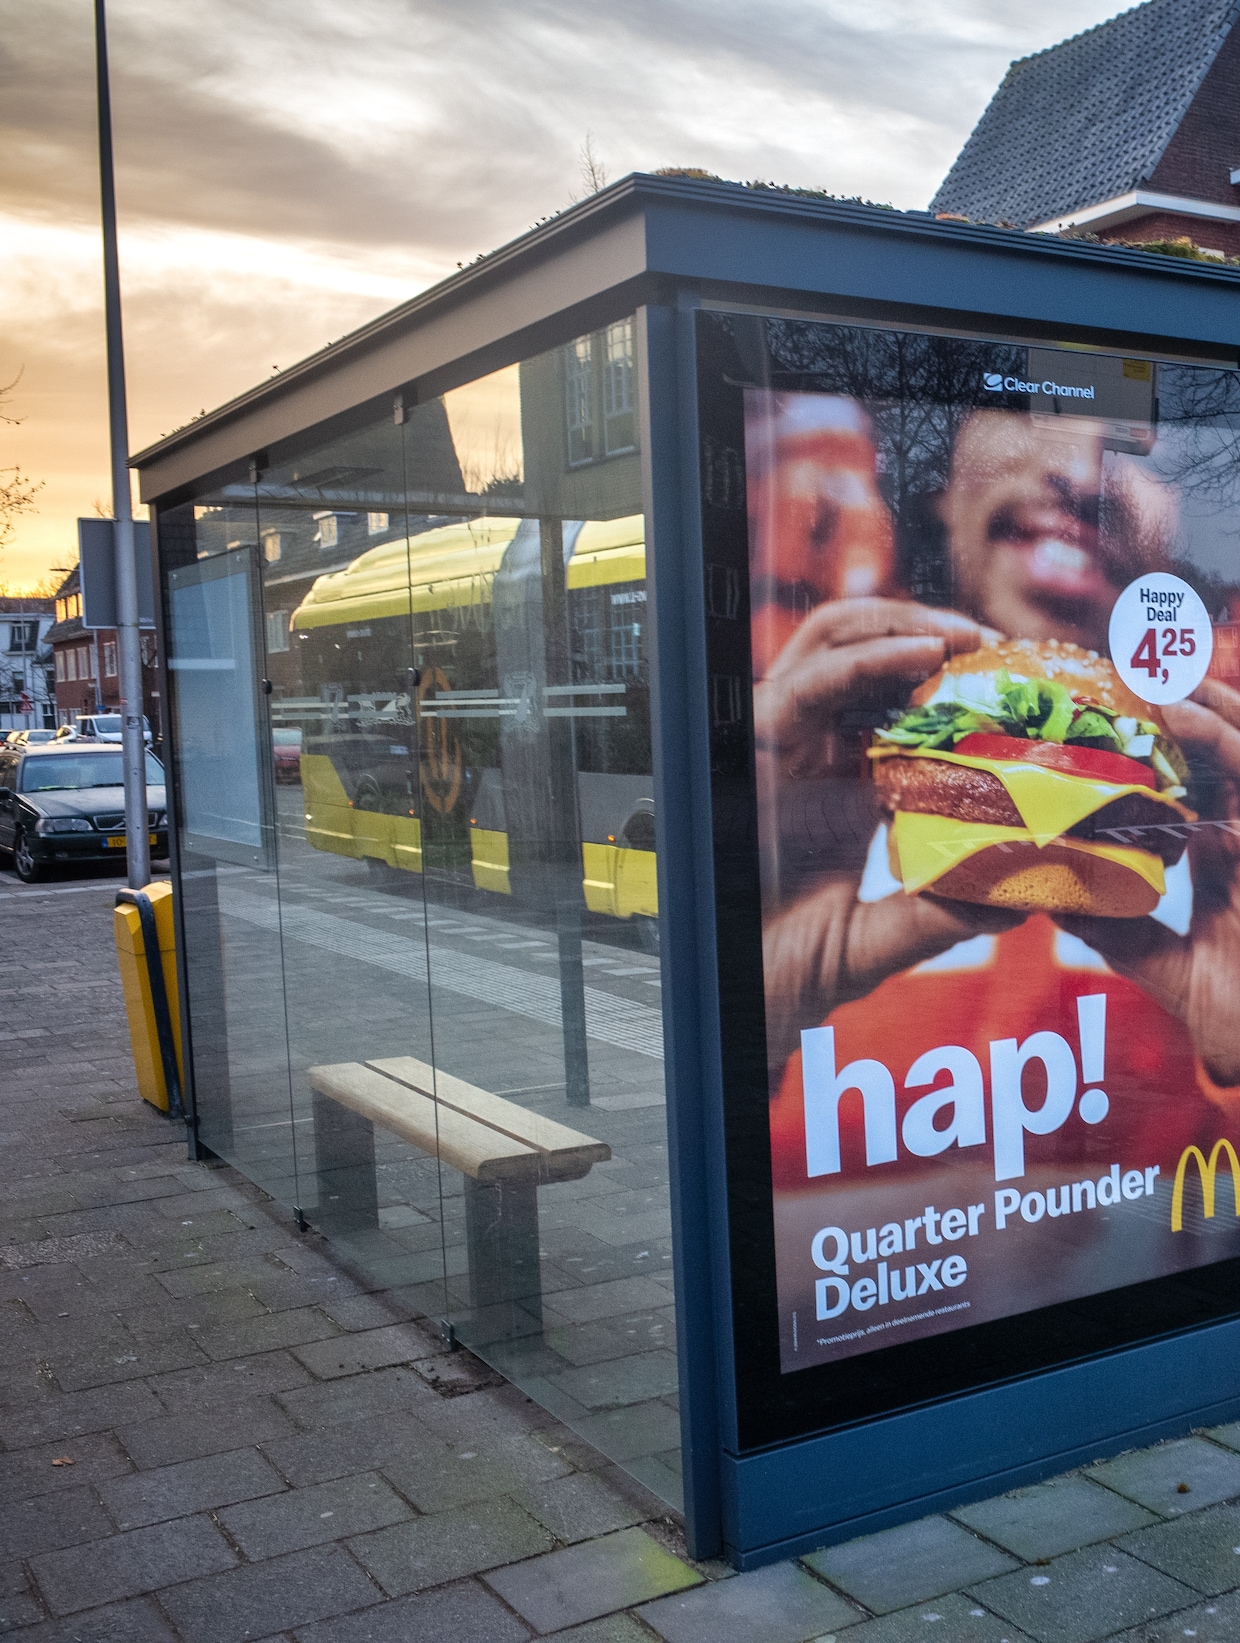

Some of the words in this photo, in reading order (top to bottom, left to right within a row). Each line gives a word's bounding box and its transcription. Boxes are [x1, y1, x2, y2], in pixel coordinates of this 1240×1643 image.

[1003, 376, 1040, 394] Clear
[1041, 381, 1095, 399] Channel
[1139, 588, 1185, 608] Happy
[1146, 606, 1177, 622] Deal
[800, 993, 1110, 1181] hap!
[811, 1201, 985, 1276] Quarter
[994, 1164, 1161, 1231] Pounder
[814, 1254, 967, 1322] Deluxe
[934, 1300, 972, 1317] restaurants
